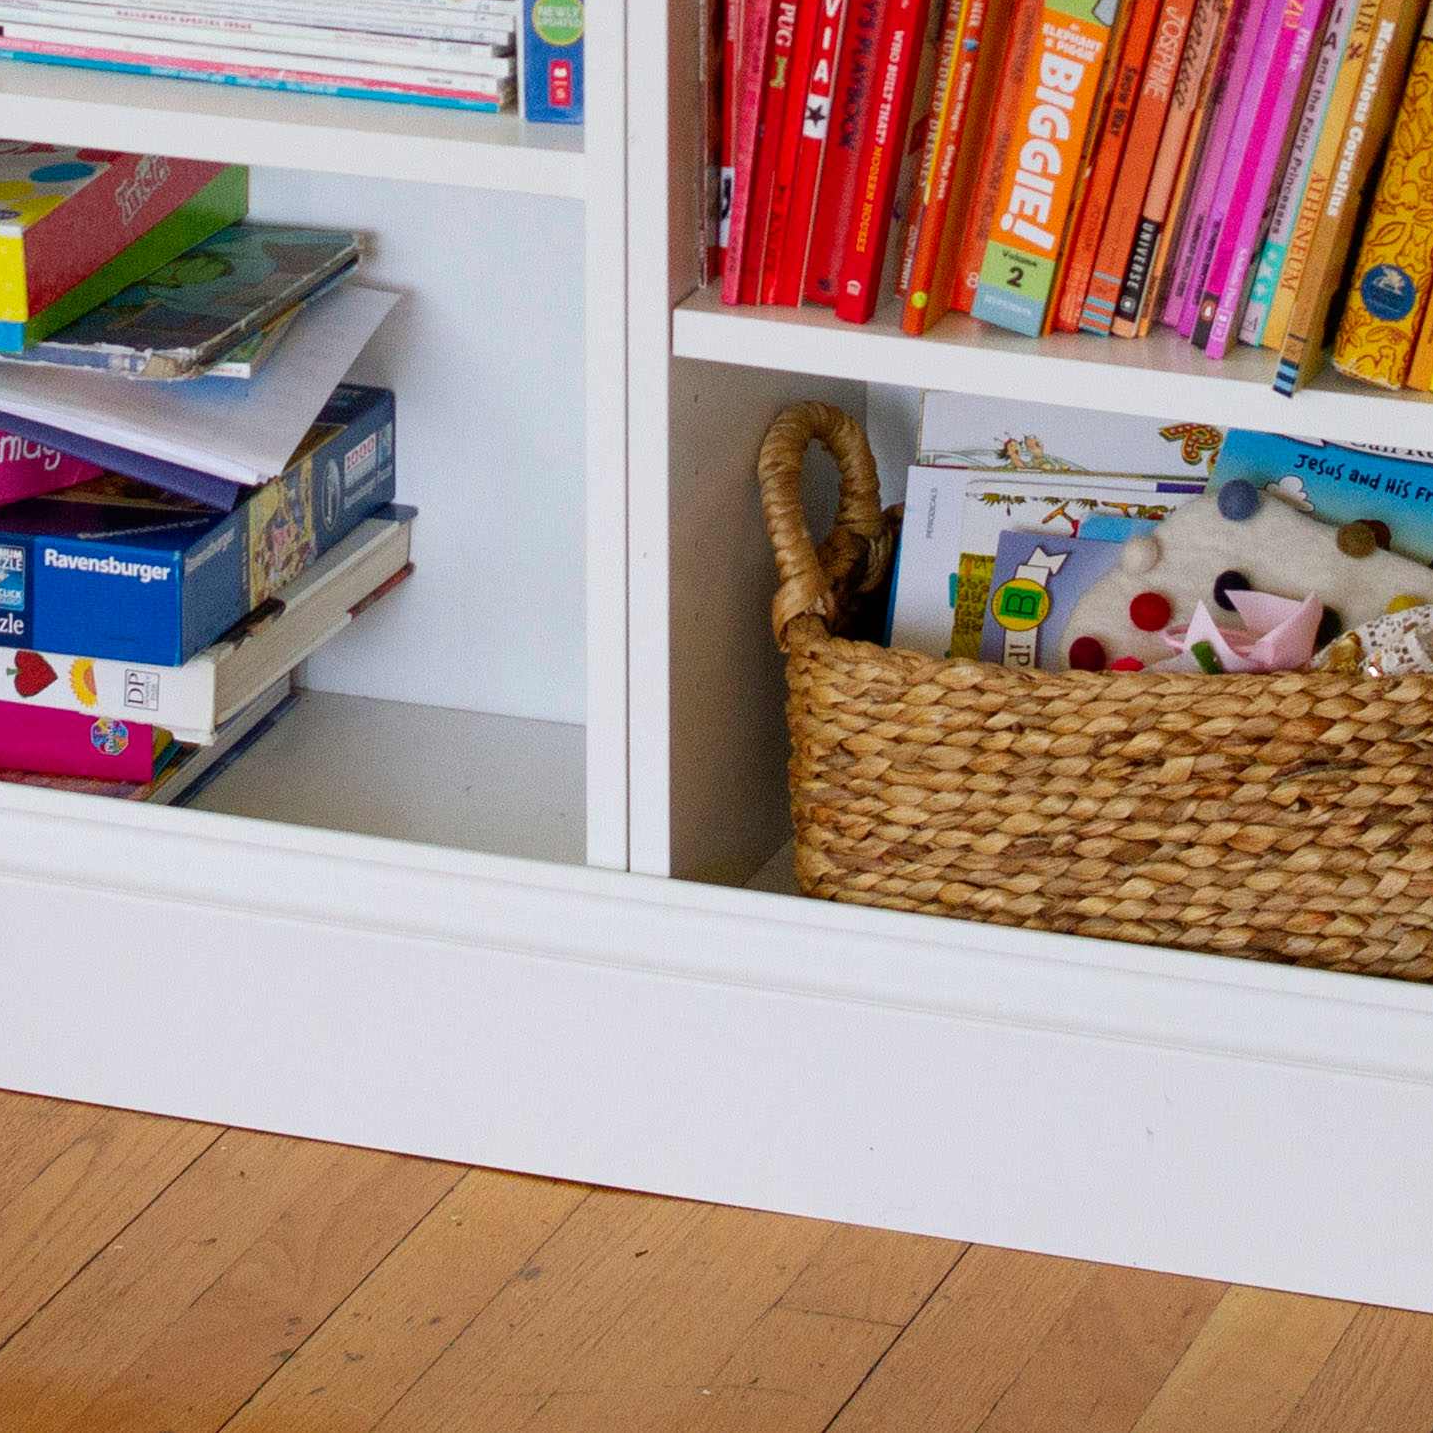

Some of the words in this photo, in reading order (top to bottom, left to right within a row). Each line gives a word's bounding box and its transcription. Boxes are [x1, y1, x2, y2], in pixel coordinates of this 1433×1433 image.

[774, 2, 797, 47] PUG
[1355, 0, 1377, 34] AIR
[887, 29, 905, 63] WHO
[1143, 6, 1188, 104] JOSEPHINE
[879, 63, 899, 101] BUILT
[1354, 19, 1396, 123] Marvelous
[874, 102, 892, 145] THAT?
[865, 145, 884, 202] MODERN
[1000, 51, 1084, 251] BIGGIE!
[1326, 125, 1362, 218] Cornelius
[854, 202, 876, 253] HOUSES
[1280, 171, 1327, 292] ATHENEUM
[1005, 267, 1025, 291] 2
[1129, 220, 1156, 290] UNIVERSE
[1293, 452, 1344, 481] Jesus
[1348, 472, 1379, 492] and
[1384, 477, 1409, 499] His
[43, 549, 172, 582] Ravensburger
